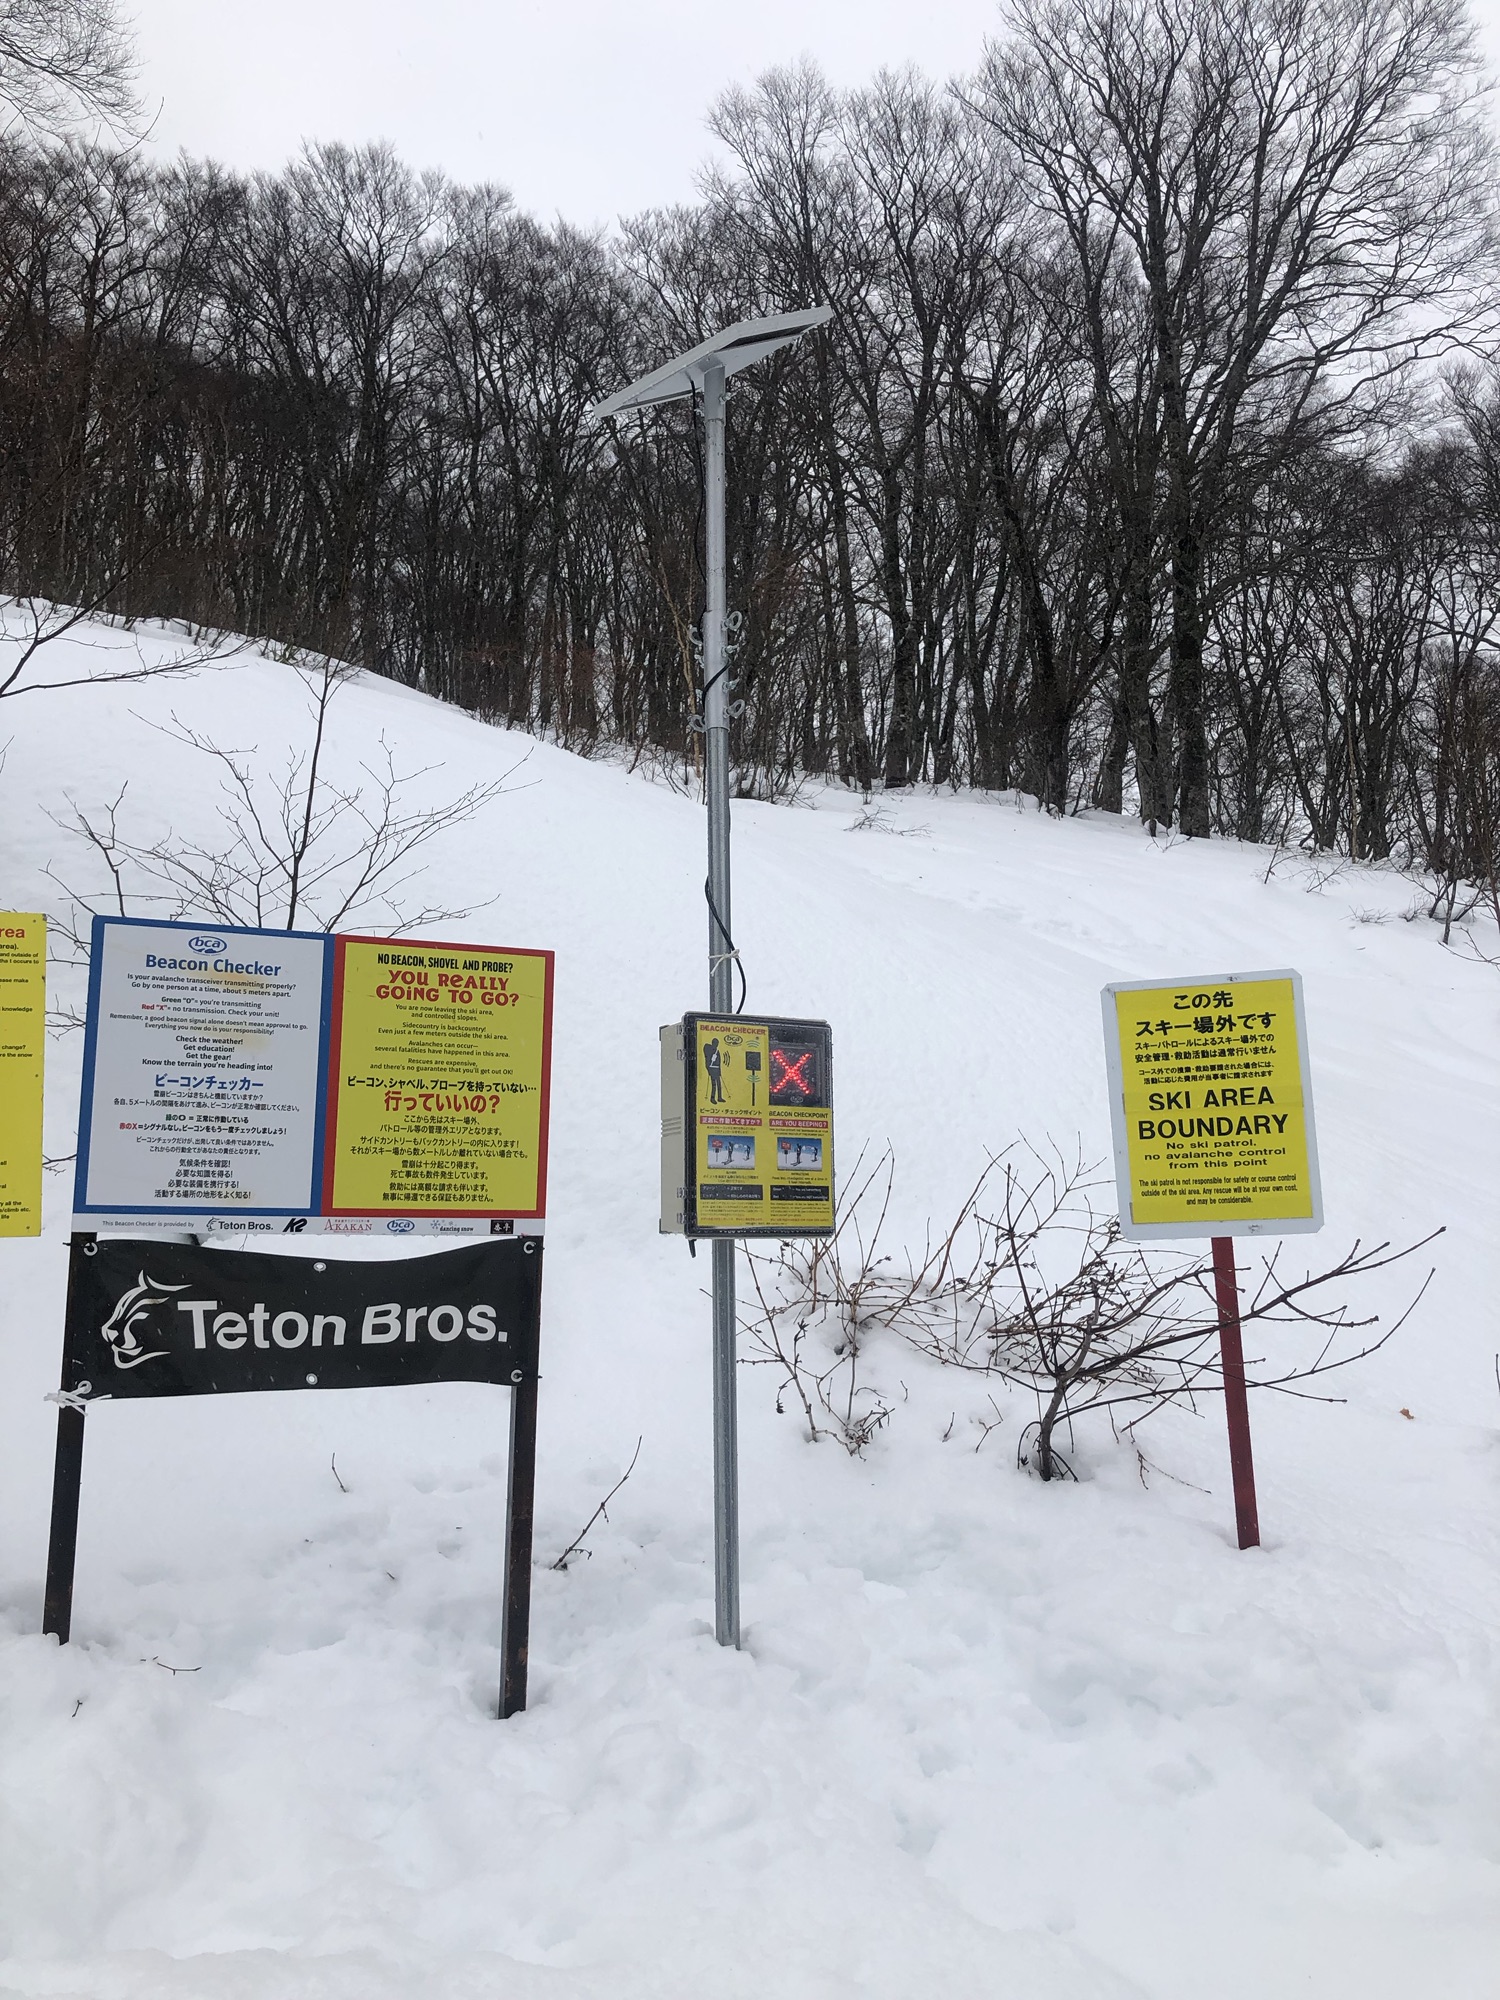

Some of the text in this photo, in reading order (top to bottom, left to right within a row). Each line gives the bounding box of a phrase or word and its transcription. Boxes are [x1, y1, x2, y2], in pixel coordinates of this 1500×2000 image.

[195, 936, 220, 947] bca
[146, 954, 281, 976] Beacon Checker
[378, 953, 513, 973] NO BEACON, SHOVEL AND PROBE?
[224, 979, 264, 989] transmitting
[448, 989, 473, 1004] TO
[481, 991, 519, 1007] GO?
[1173, 990, 1234, 1010] この先
[182, 1006, 227, 1014] transmission.
[221, 1000, 262, 1010] transmitting
[434, 1006, 456, 1015] leaving
[402, 1022, 440, 1031] Sidecountry
[447, 1024, 486, 1033] backcountry!
[700, 1025, 766, 1035] BEACON CHECKER
[1136, 1012, 1276, 1037] スキー場外です
[197, 1045, 235, 1053] education!
[1135, 1034, 1275, 1051] スキーパトロールによるスキー場外での
[1135, 1045, 1276, 1063] 安全管理・救助活動は通常行いません
[227, 1062, 256, 1071] heading
[155, 1073, 264, 1091] ビーコンチェッカー
[384, 1090, 500, 1114] 行っていいの？
[1149, 1086, 1274, 1111] SKI AREA
[1138, 1114, 1288, 1140] BOUNDARY
[1190, 1141, 1208, 1149] ski
[1214, 1139, 1256, 1148] patrol.
[1166, 1150, 1233, 1160] avalanche
[1239, 1147, 1286, 1157] control
[1234, 1158, 1267, 1168] point
[1159, 1178, 1175, 1187] patrol
[1192, 1177, 1223, 1185] responsible
[1277, 1174, 1296, 1182] control
[1218, 1196, 1253, 1204] considerable.
[218, 1221, 274, 1230] Teton Bros.
[282, 1218, 308, 1233] K2
[392, 1220, 410, 1228] bca
[177, 1299, 509, 1350] Teton Bros.
